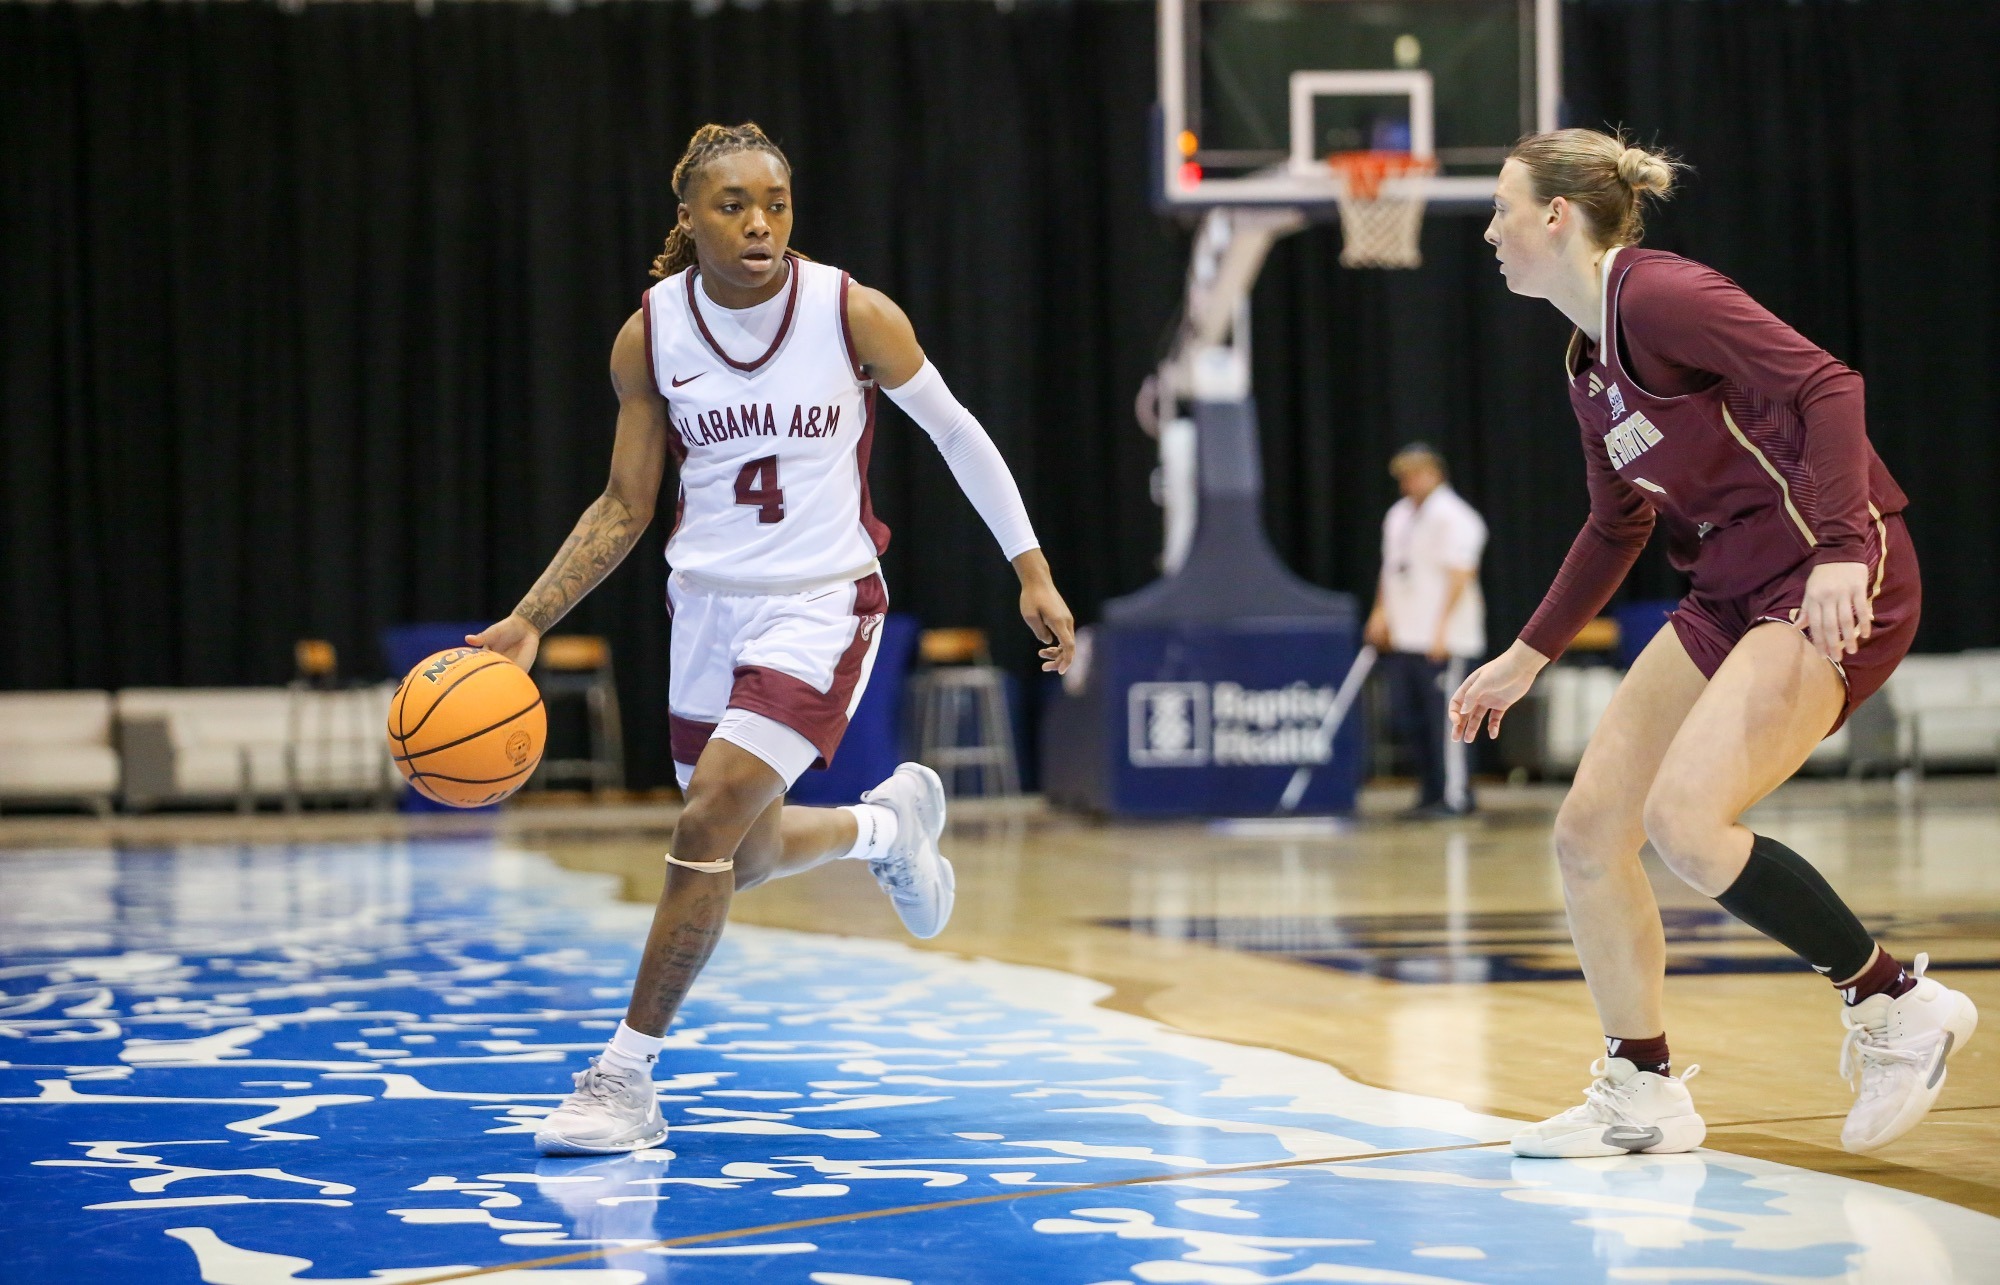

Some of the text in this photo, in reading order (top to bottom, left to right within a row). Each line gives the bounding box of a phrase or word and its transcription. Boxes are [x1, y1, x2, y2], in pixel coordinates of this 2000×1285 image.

[678, 403, 841, 447] ALABAMA A&M
[734, 454, 785, 525] 4
